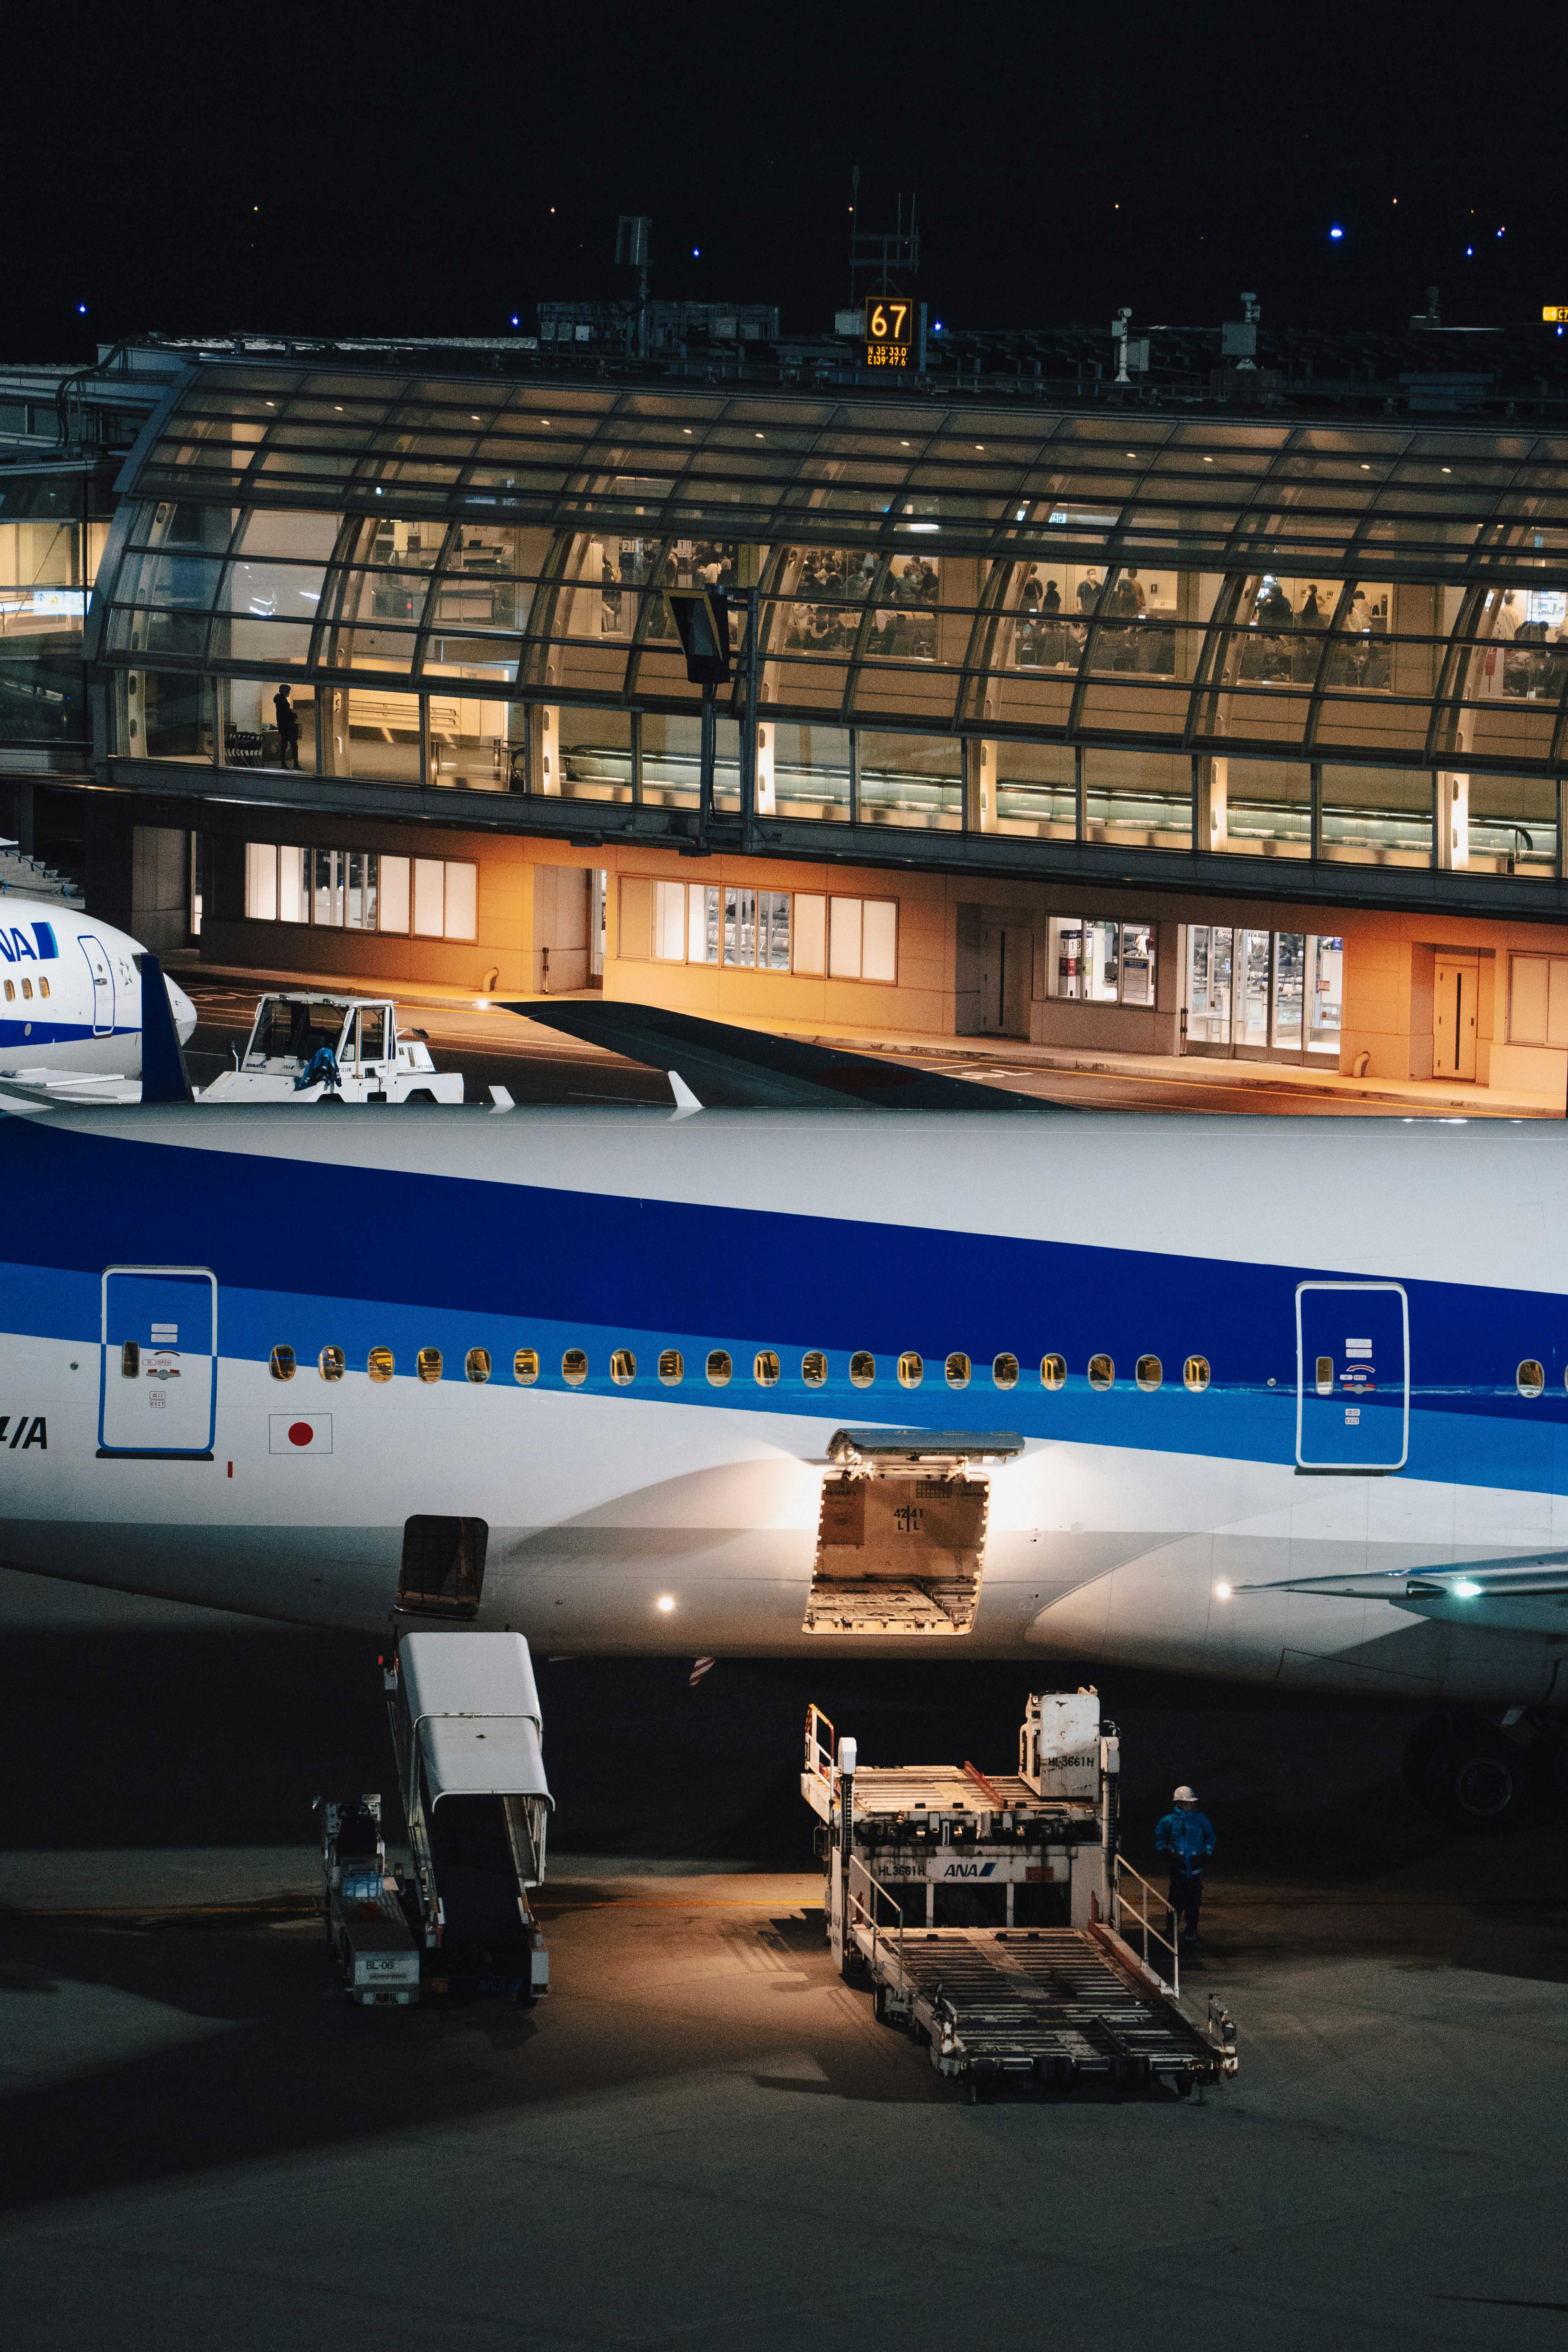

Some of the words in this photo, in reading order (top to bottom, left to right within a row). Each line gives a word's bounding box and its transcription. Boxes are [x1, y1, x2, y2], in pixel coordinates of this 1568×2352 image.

[871, 305, 907, 339] 67
[868, 346, 873, 355] N
[624, 542, 629, 551] 2
[894, 1508, 907, 1518] 42
[909, 1509, 923, 1518] 41
[898, 1521, 903, 1530] L
[913, 1521, 919, 1530] L
[1048, 1756, 1094, 1767] HL3661H
[878, 1866, 926, 1876] HL3661H
[944, 1864, 978, 1877] ANA
[366, 1961, 394, 1970] BL-06
